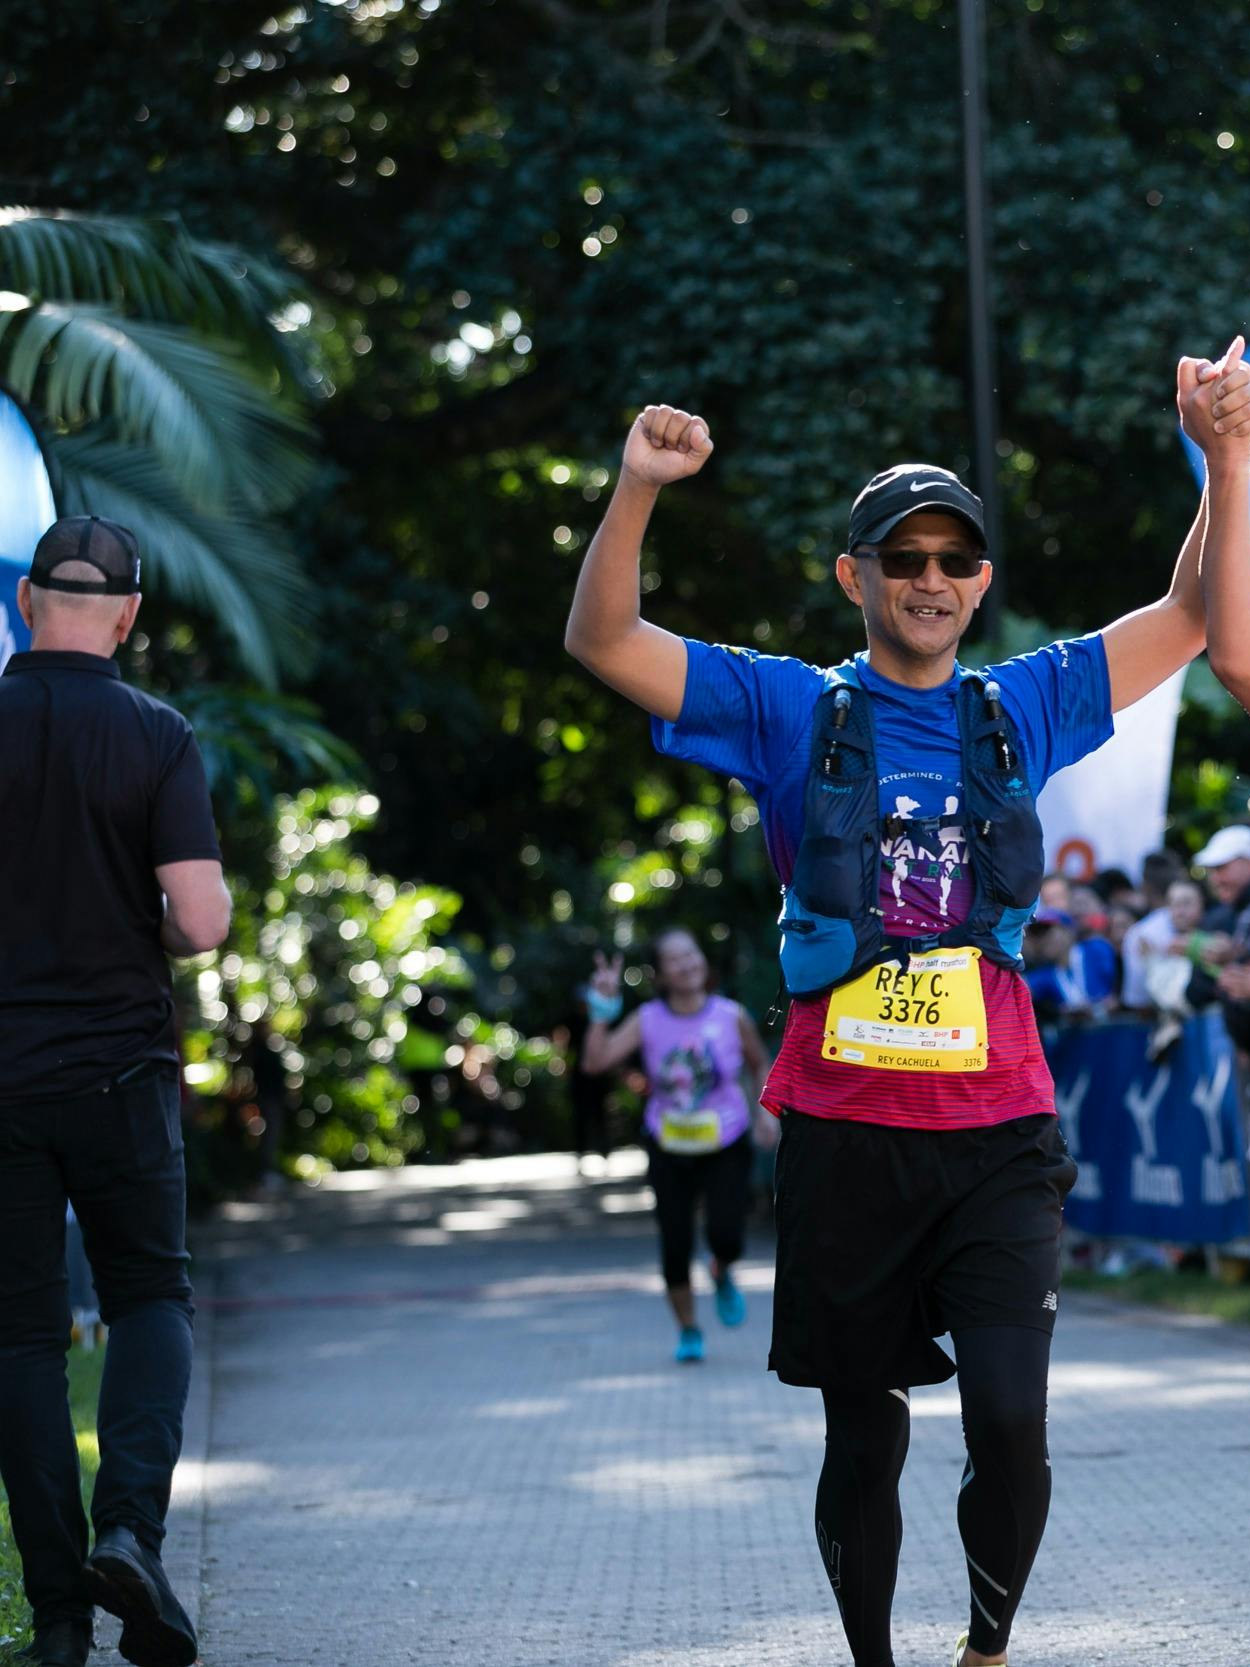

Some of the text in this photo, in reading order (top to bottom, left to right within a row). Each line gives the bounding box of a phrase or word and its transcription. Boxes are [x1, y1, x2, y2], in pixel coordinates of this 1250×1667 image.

[875, 966, 949, 998] REY C.
[878, 996, 940, 1025] 3376
[878, 1055, 940, 1068] REY CACHUELA
[963, 1058, 982, 1067] 3376
